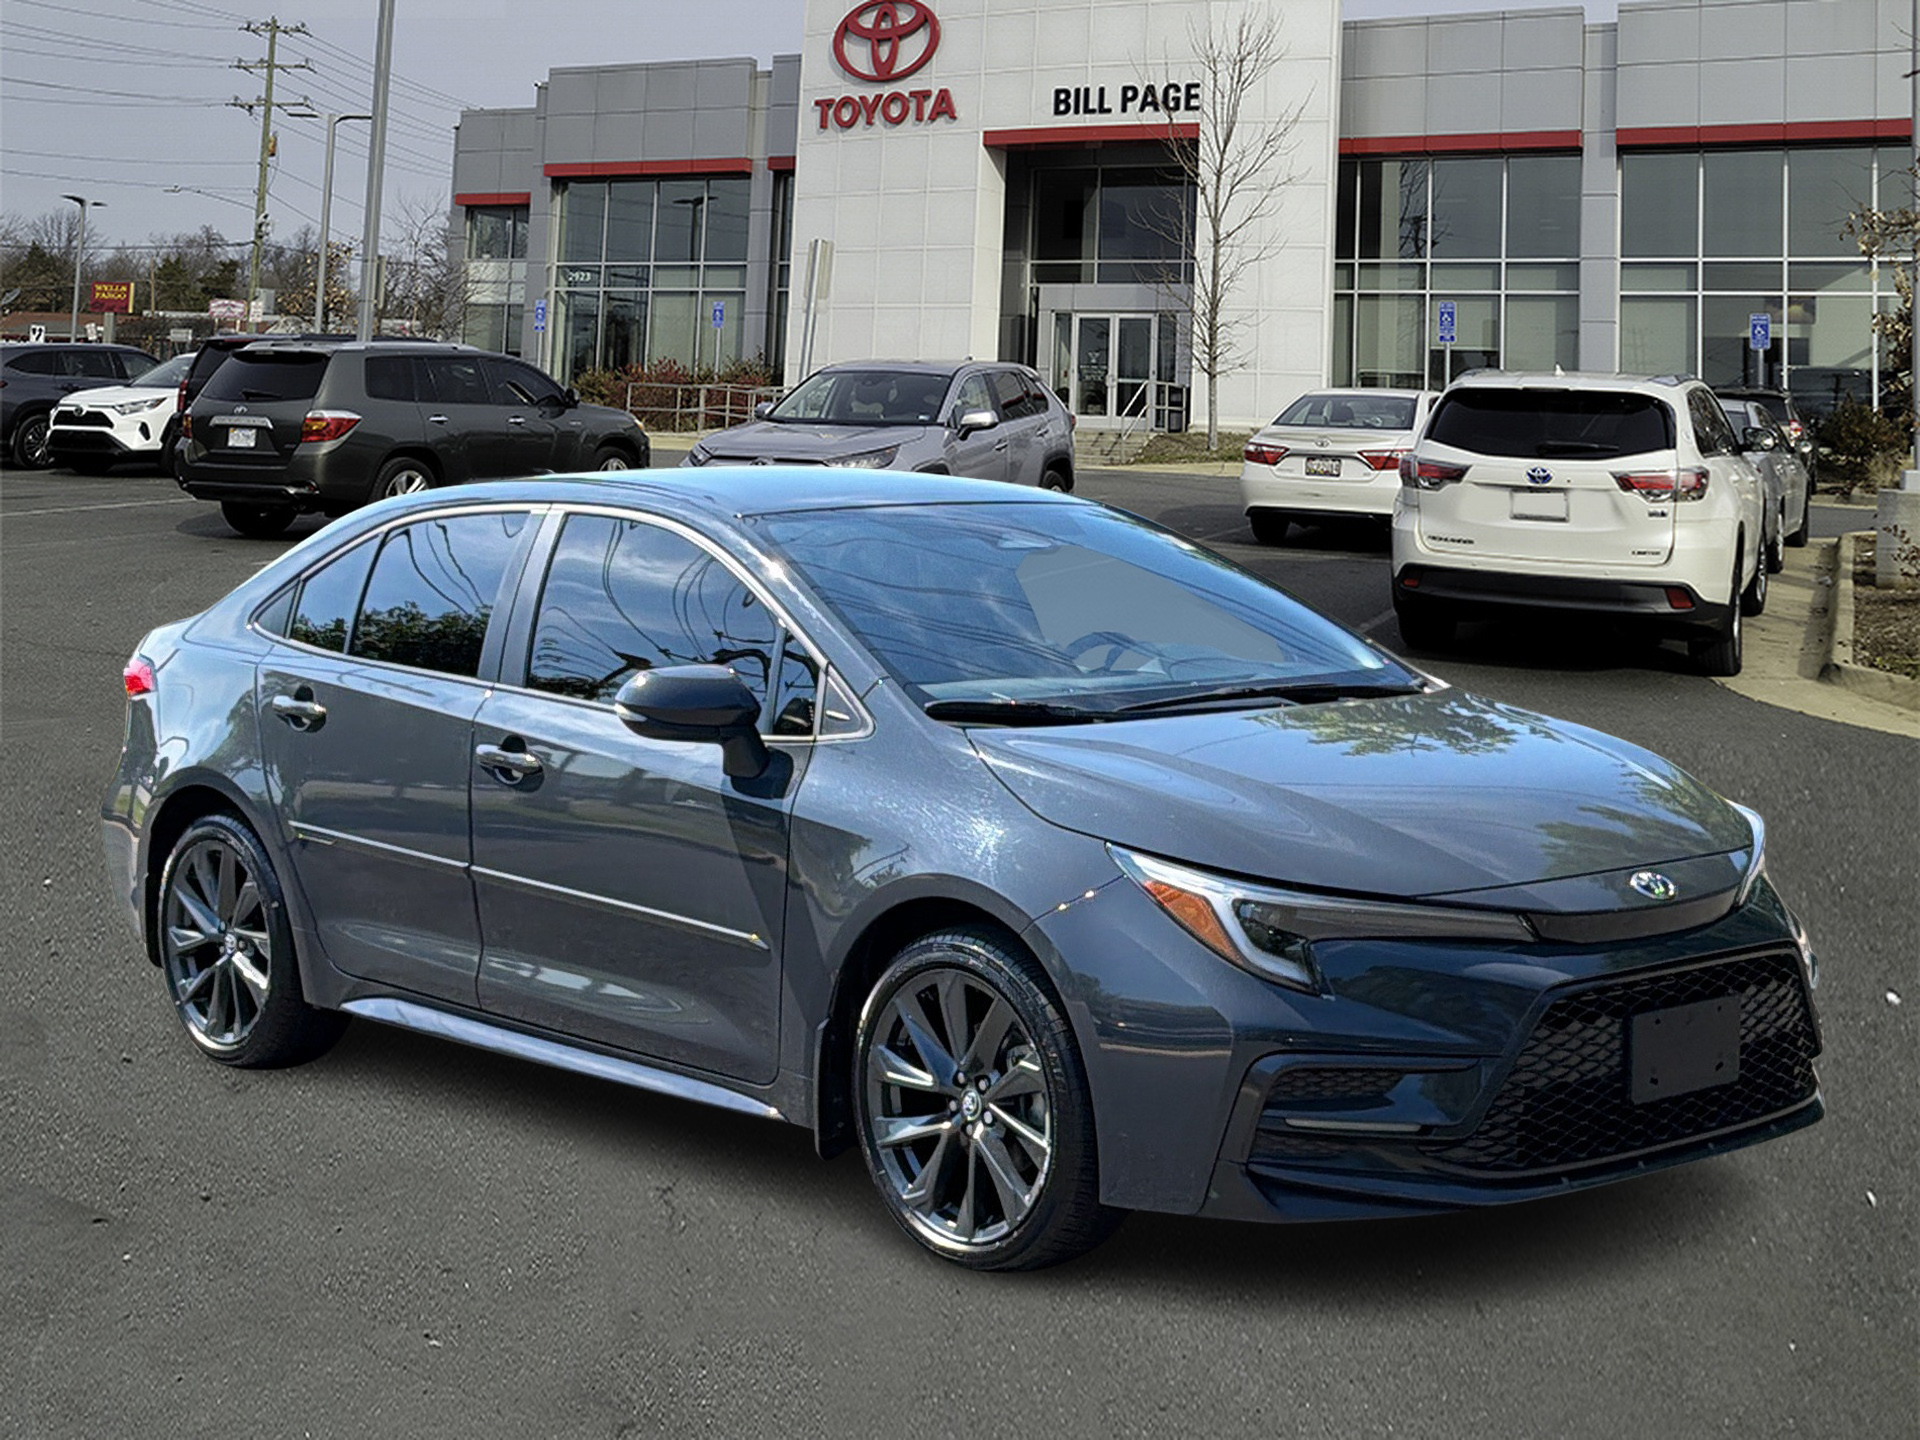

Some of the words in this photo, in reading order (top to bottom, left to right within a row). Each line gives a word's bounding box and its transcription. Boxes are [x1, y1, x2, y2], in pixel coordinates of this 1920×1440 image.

[814, 88, 958, 129] TOYOTA
[1053, 86, 1112, 116] BILL
[1120, 82, 1201, 113] PAGE
[94, 283, 127, 291] WELLS
[95, 291, 127, 300] FARGO
